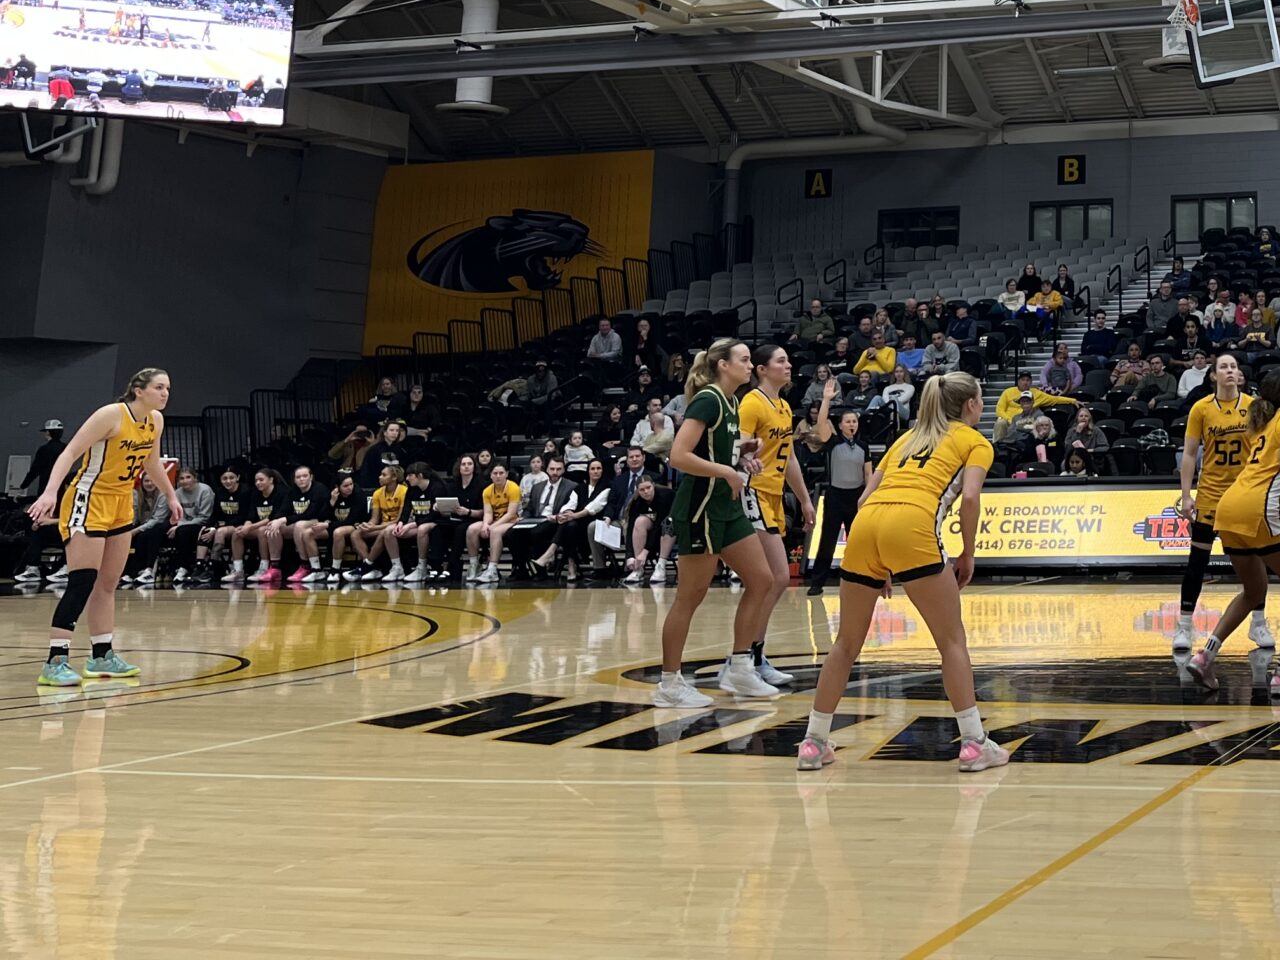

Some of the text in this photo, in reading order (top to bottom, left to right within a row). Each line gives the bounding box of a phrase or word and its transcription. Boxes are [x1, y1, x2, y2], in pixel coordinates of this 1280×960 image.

[1064, 158, 1080, 182] B
[810, 172, 827, 196] A
[776, 442, 789, 472] 5
[1215, 440, 1242, 466] 52
[1250, 435, 1266, 464] 2
[985, 507, 998, 516] W.
[1003, 505, 1084, 516] BROADWICK
[1090, 505, 1107, 515] PL
[949, 519, 1103, 536] OK CREEK, WI
[1148, 518, 1190, 537] TEX
[1008, 539, 1076, 550] 676-2022
